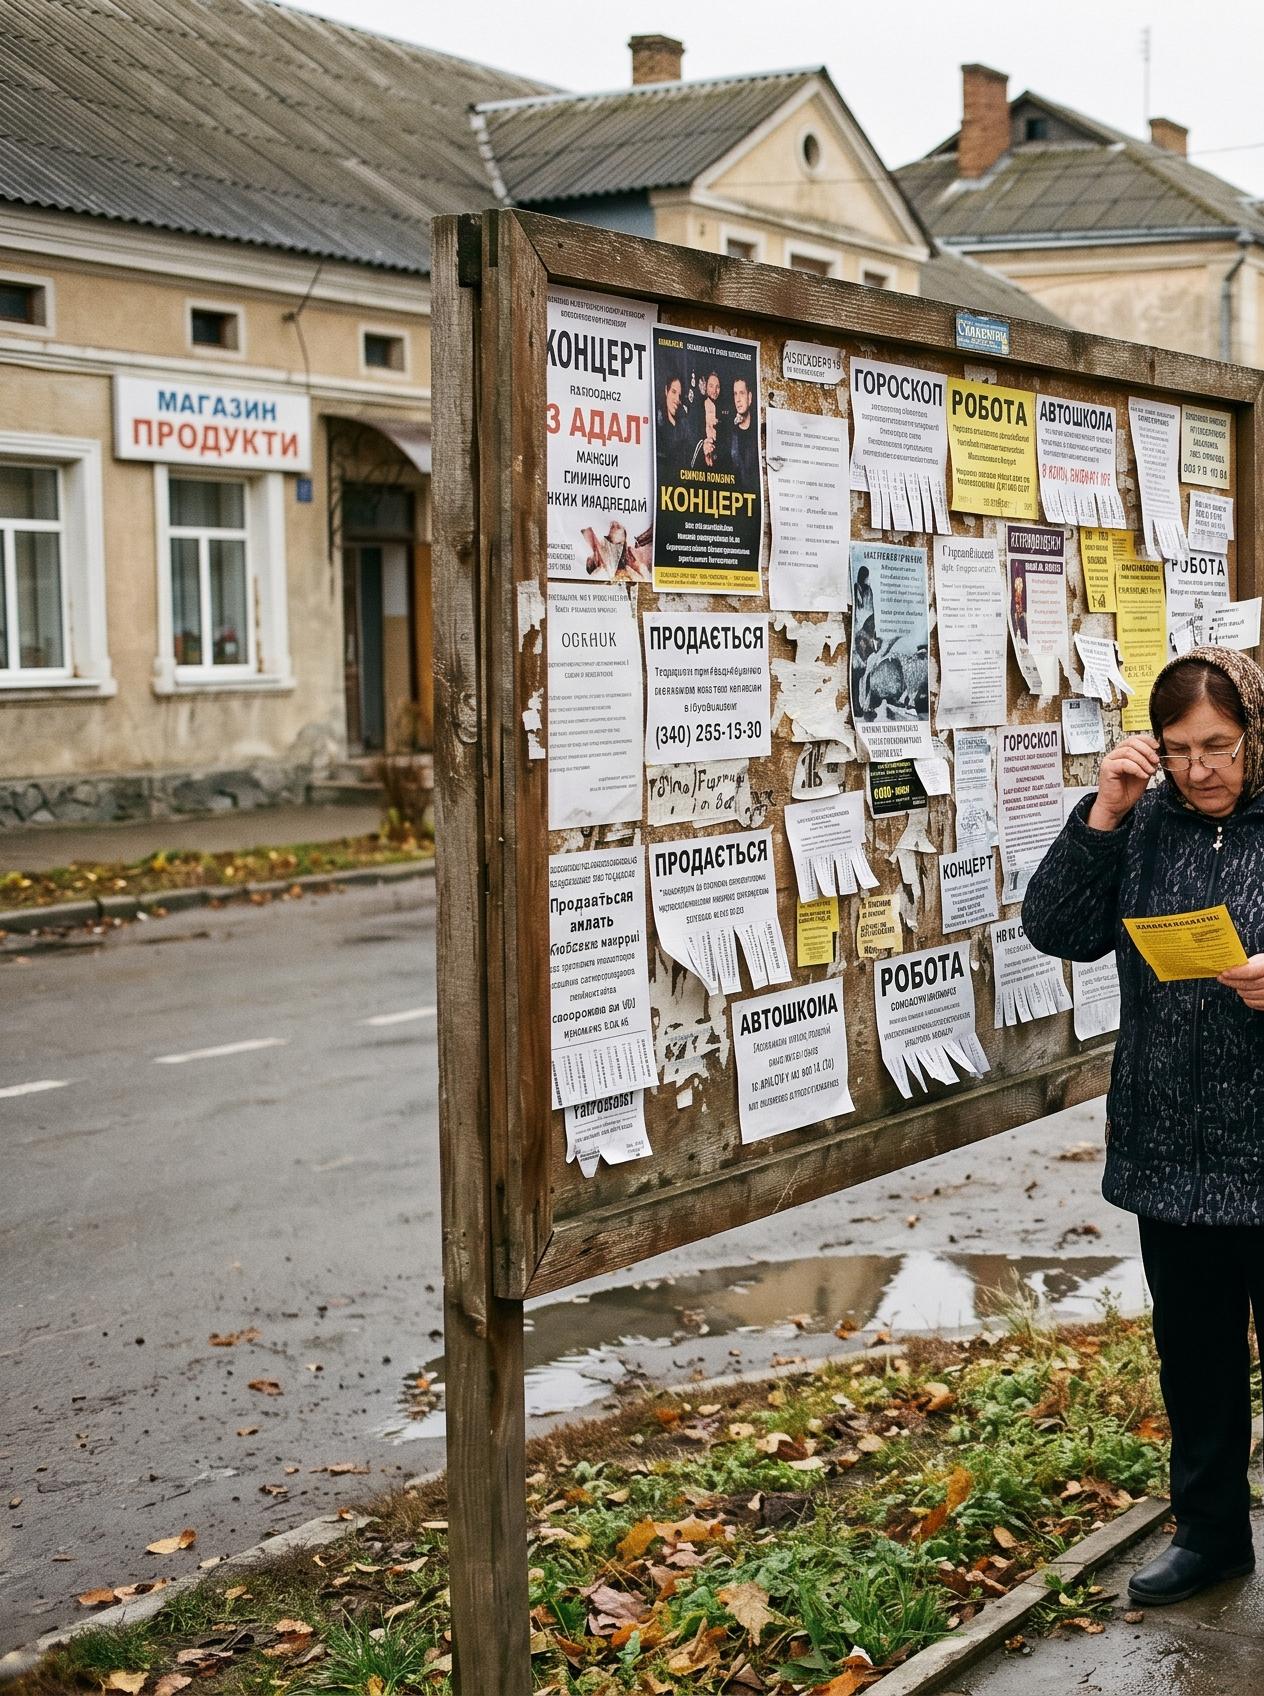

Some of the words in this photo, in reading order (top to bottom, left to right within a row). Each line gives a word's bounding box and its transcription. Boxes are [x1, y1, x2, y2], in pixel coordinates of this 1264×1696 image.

[854, 368, 943, 407] ГОРОСКОП
[158, 389, 277, 422] МАГАЗИН
[951, 389, 1028, 427] РОБОТА
[1039, 401, 1114, 432] АВТОШКОЛА
[133, 418, 298, 458] ПРОДУКТИ
[661, 485, 757, 519] КОНЦЕРТ
[649, 626, 764, 654] ПРОДАЄТЬСЯ
[655, 724, 691, 750] (340)
[1003, 730, 1058, 752] ГОРОСКОП
[655, 839, 768, 877] ПРОДАЄТЬСЯ
[942, 854, 993, 880] КОНЦЕРТ
[880, 951, 965, 997] РОБОТА
